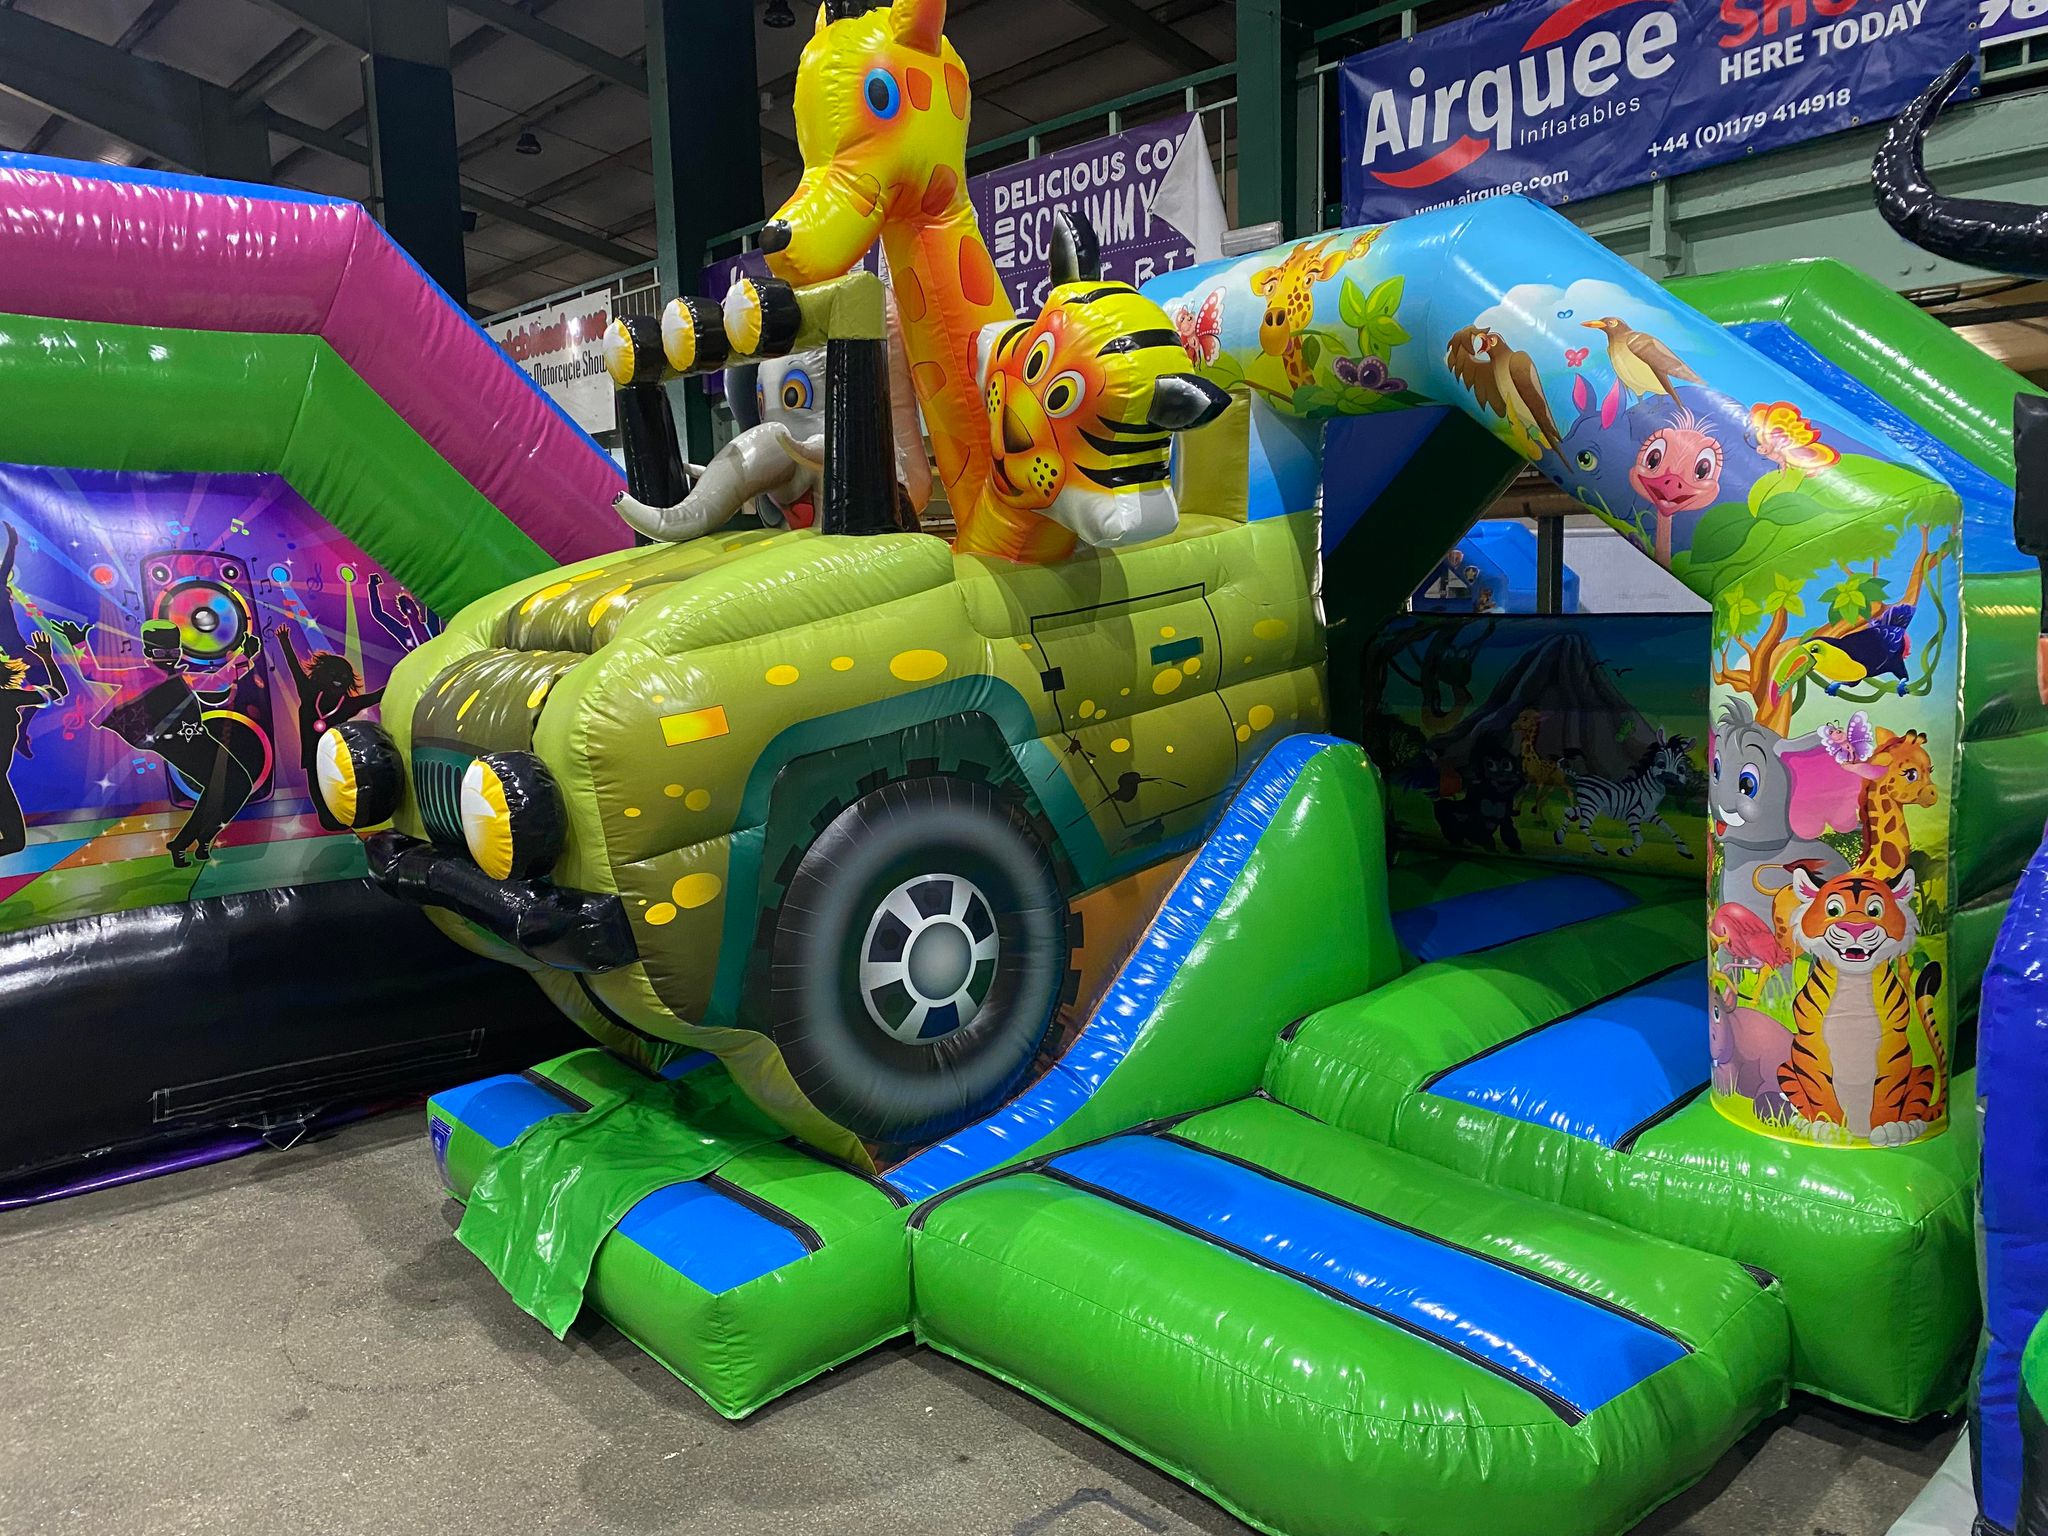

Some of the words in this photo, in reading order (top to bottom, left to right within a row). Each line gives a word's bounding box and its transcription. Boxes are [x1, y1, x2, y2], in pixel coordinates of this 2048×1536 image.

[1720, 33, 1805, 85] HERE
[1812, 0, 1927, 57] TODAY
[1361, 11, 1677, 166] Airquee
[1520, 98, 1641, 146] Inflatables
[1647, 132, 1689, 158] +44
[1695, 110, 1768, 149] (0)1179
[1772, 87, 1851, 122] 414918
[994, 151, 1126, 214] DELICIOUS
[994, 216, 1015, 268] AND
[1019, 178, 1157, 266] SCMMY
[533, 355, 581, 389] Motorcycle
